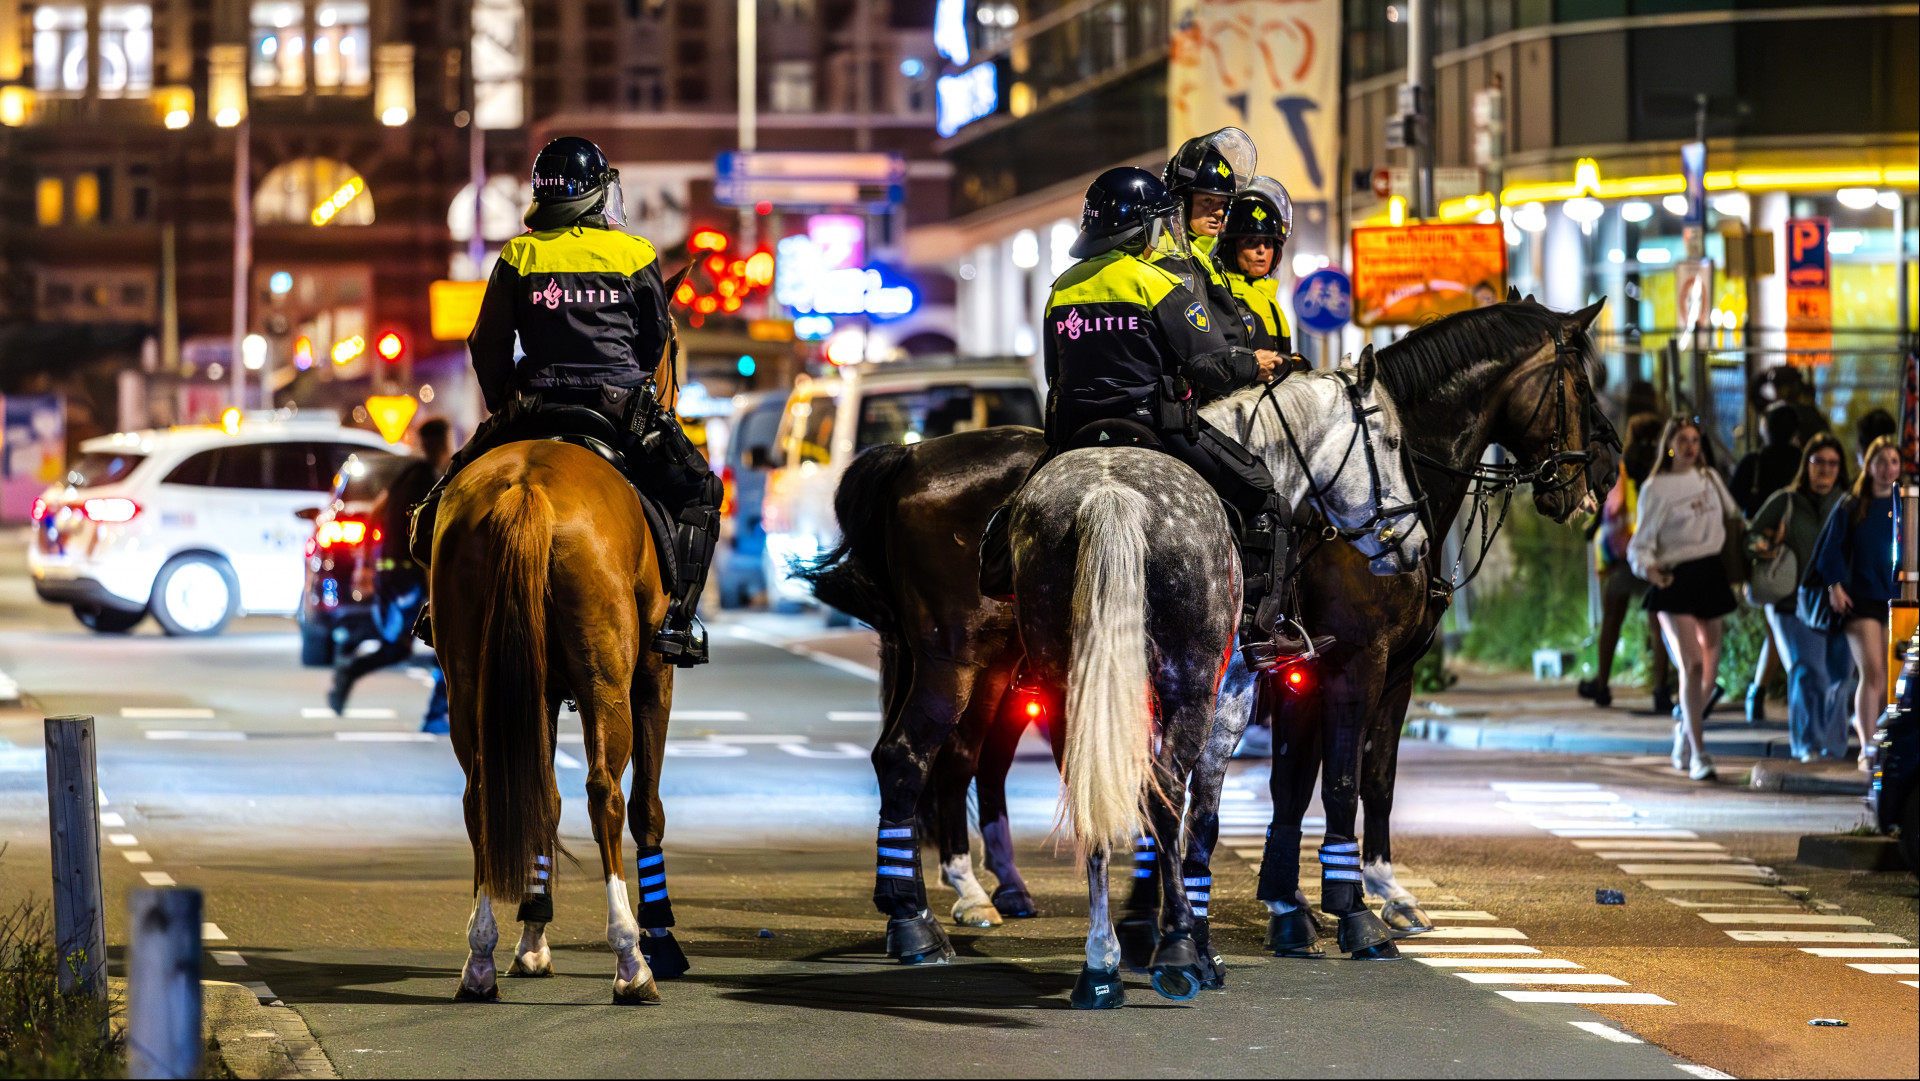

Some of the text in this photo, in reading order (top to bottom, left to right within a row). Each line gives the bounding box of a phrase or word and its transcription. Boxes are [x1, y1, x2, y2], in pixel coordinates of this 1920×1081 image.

[1793, 221, 1820, 262] P
[533, 286, 619, 309] POLITIE
[1057, 313, 1139, 339] POLITIE
